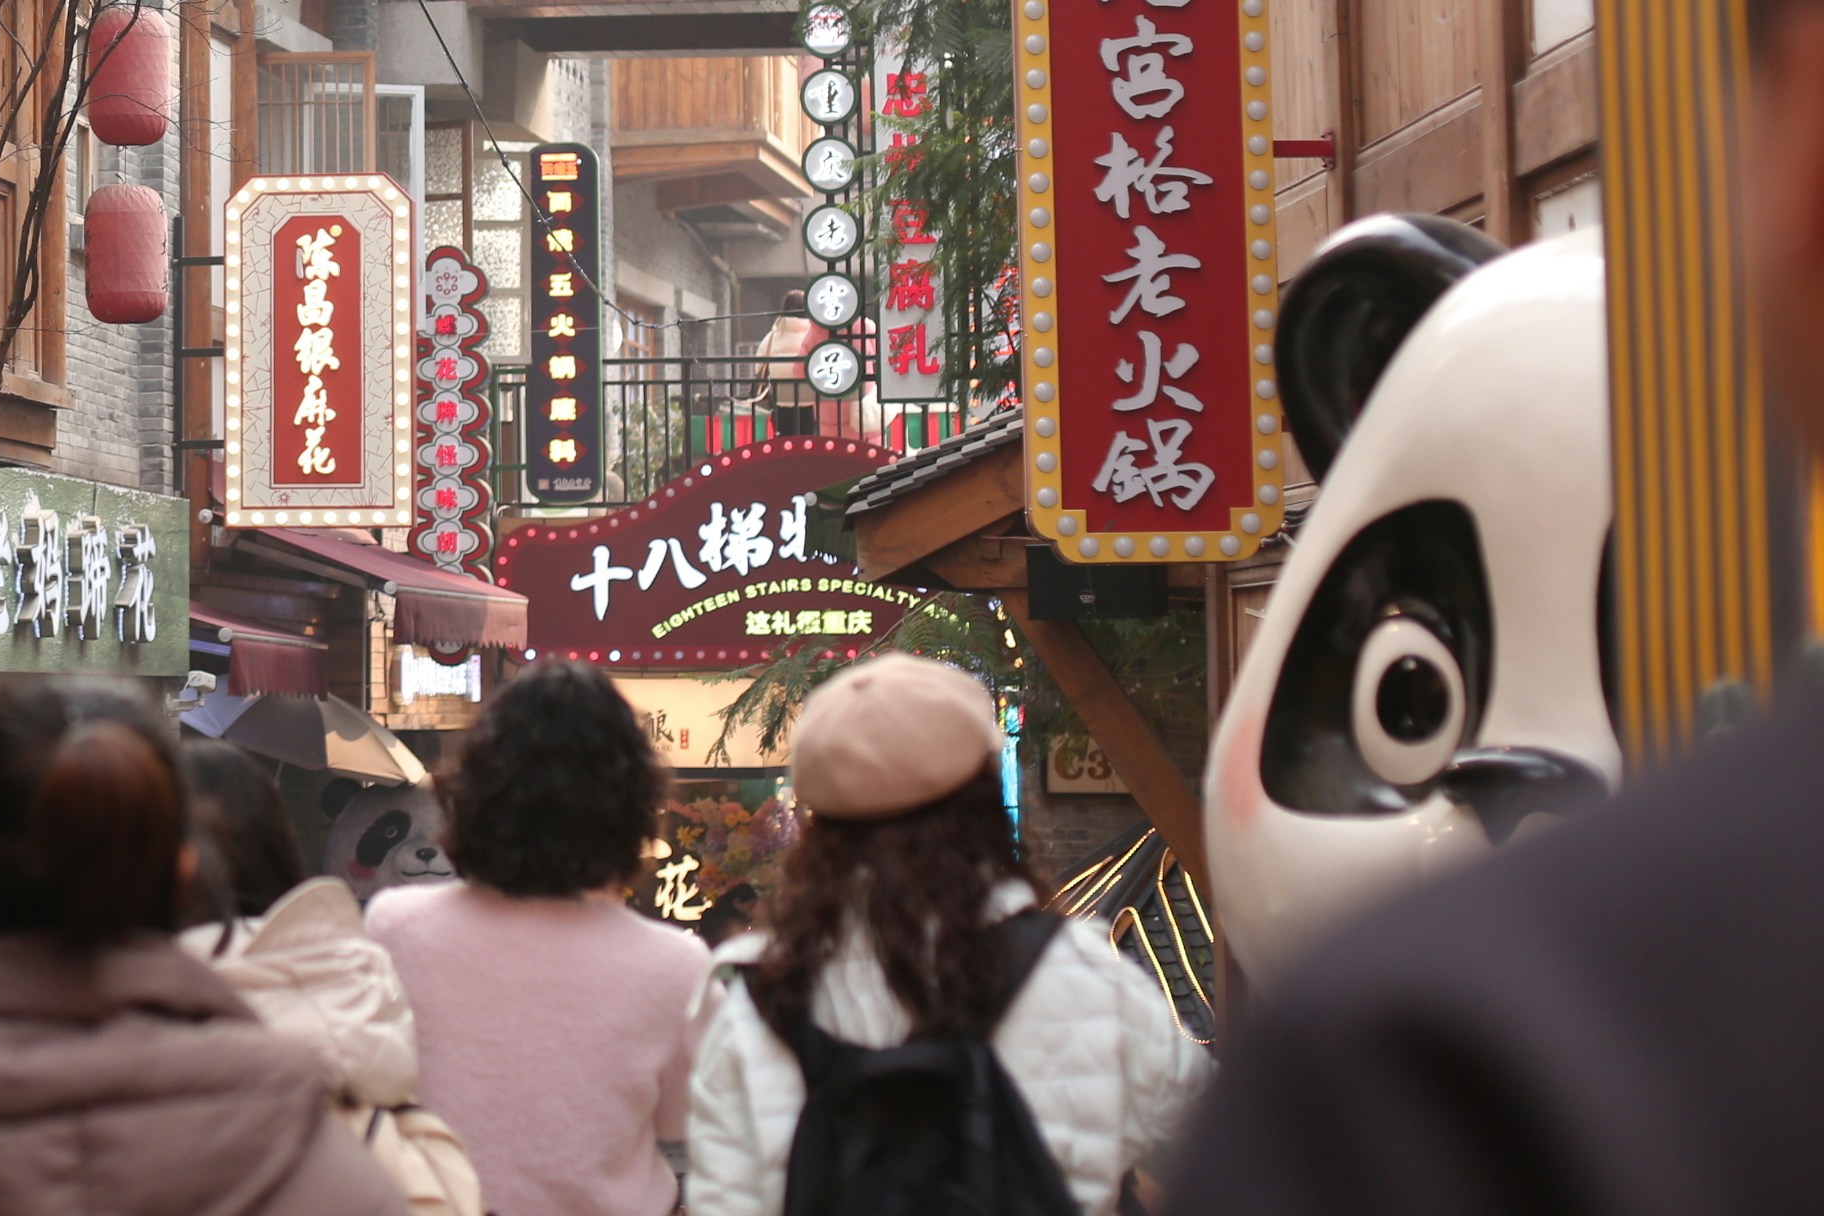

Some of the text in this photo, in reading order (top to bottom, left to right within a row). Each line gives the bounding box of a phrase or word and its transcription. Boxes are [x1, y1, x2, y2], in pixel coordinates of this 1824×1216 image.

[809, 79, 856, 387] 重庆老字号
[293, 228, 341, 475] 陈昌银麻花
[650, 577, 921, 640] EIGHTEEN STAIRS SPECIALTY
[745, 609, 873, 636] 这礼很重庆
